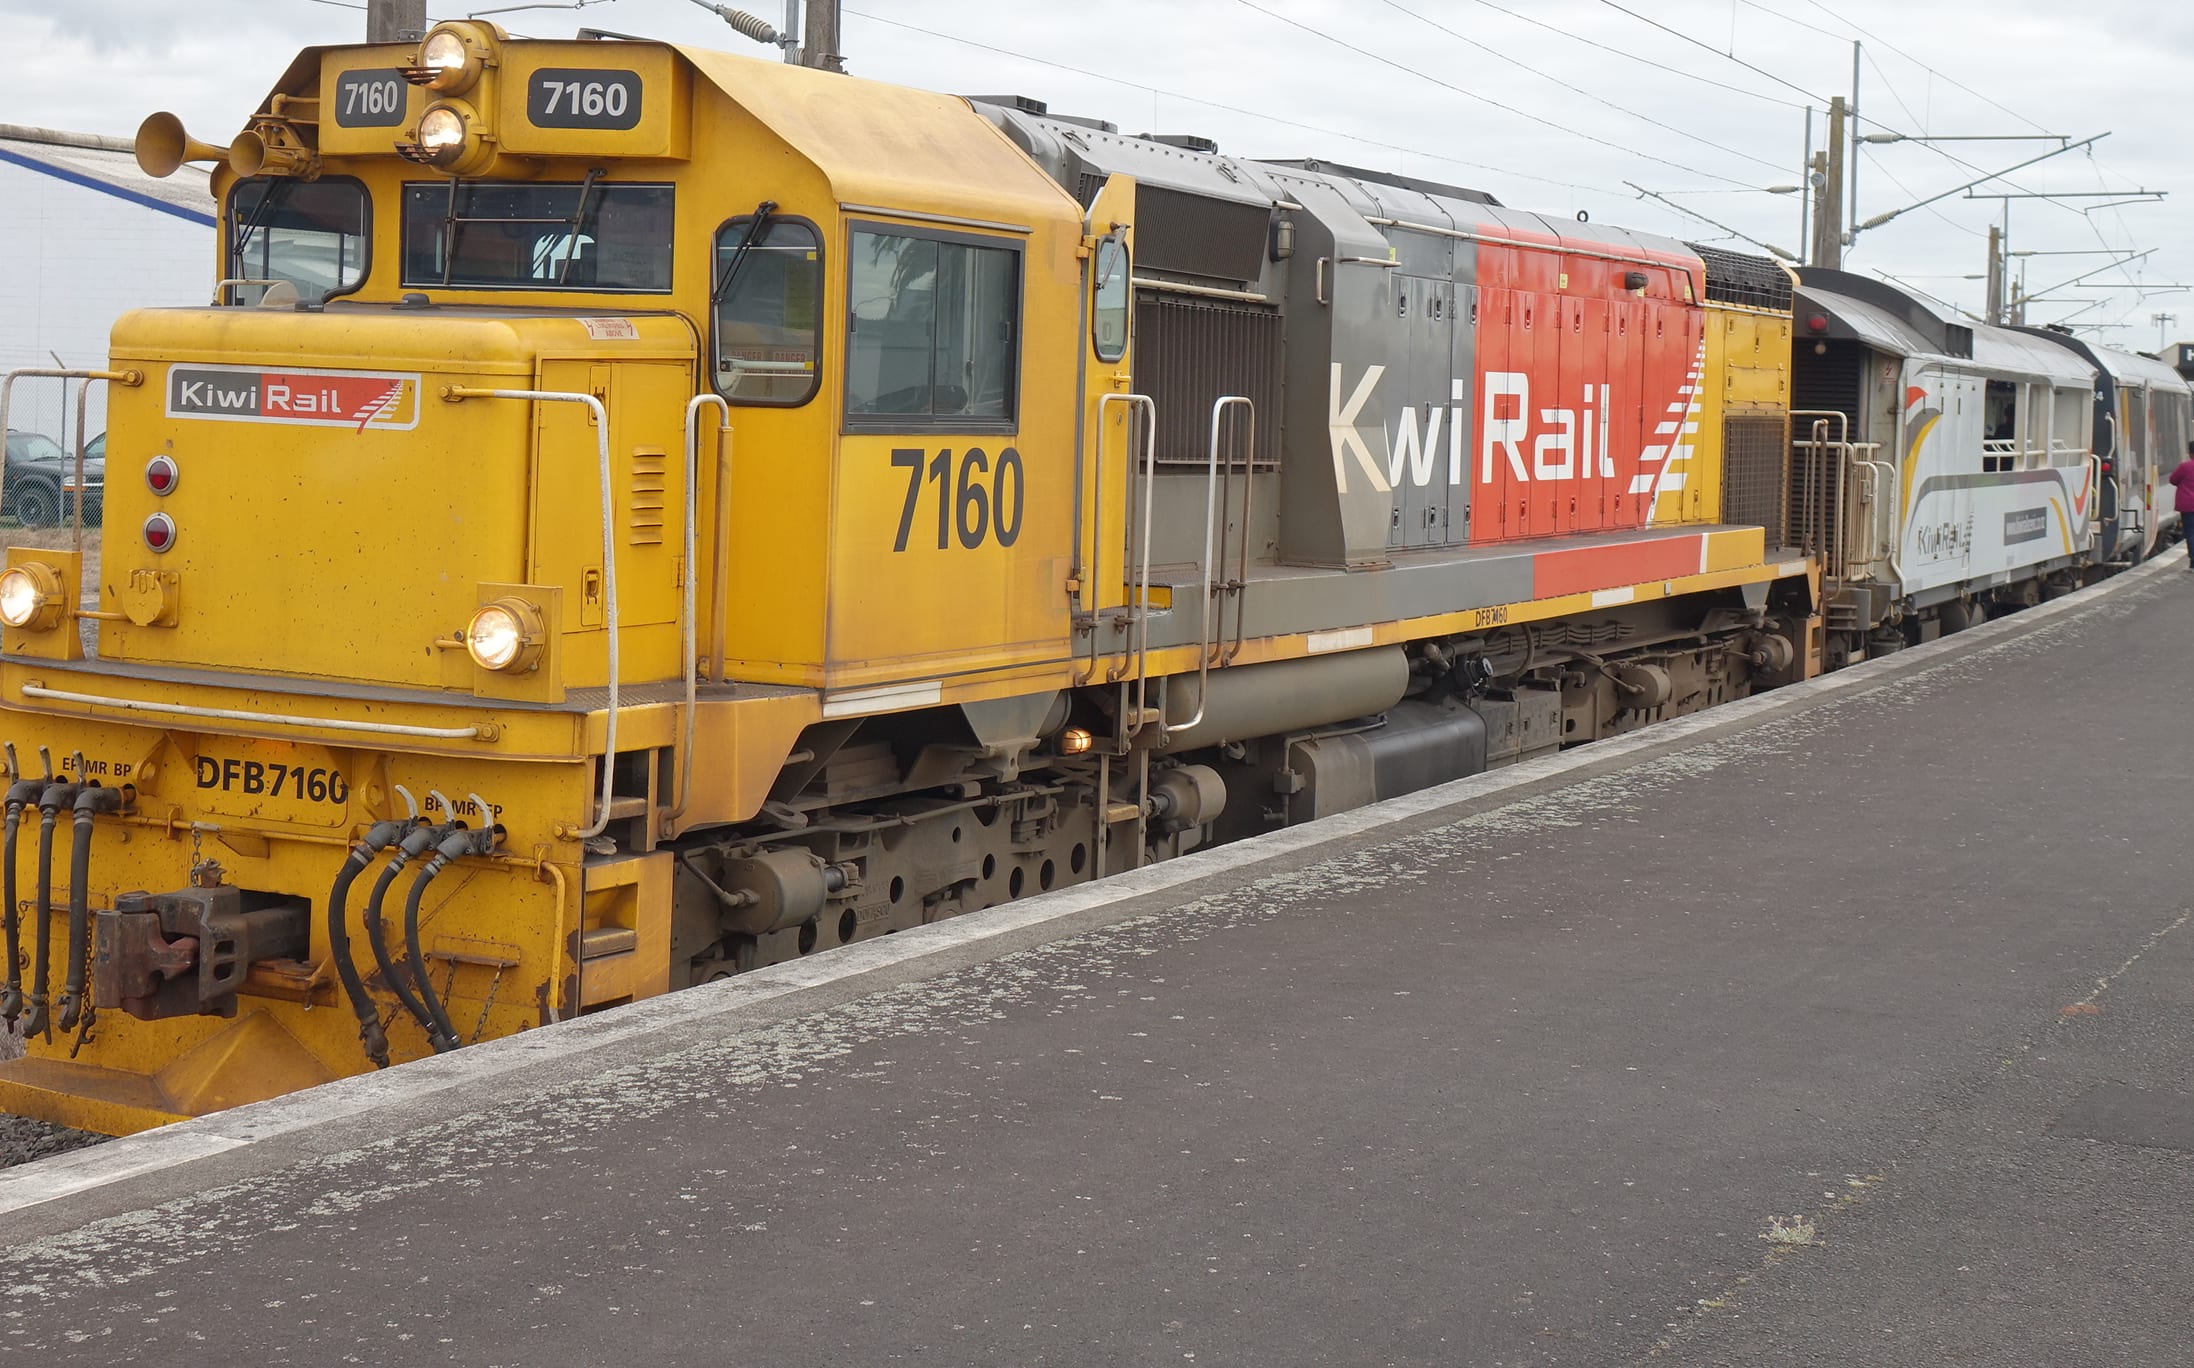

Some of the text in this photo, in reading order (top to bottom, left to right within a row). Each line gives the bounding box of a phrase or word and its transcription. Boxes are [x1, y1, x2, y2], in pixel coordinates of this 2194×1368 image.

[345, 81, 399, 115] 7160
[543, 81, 628, 117] 7160
[890, 447, 1024, 553] 7160
[85, 759, 107, 775] MR
[114, 763, 131, 777] BP
[197, 755, 349, 804] DFB7160
[452, 800, 476, 817] MR
